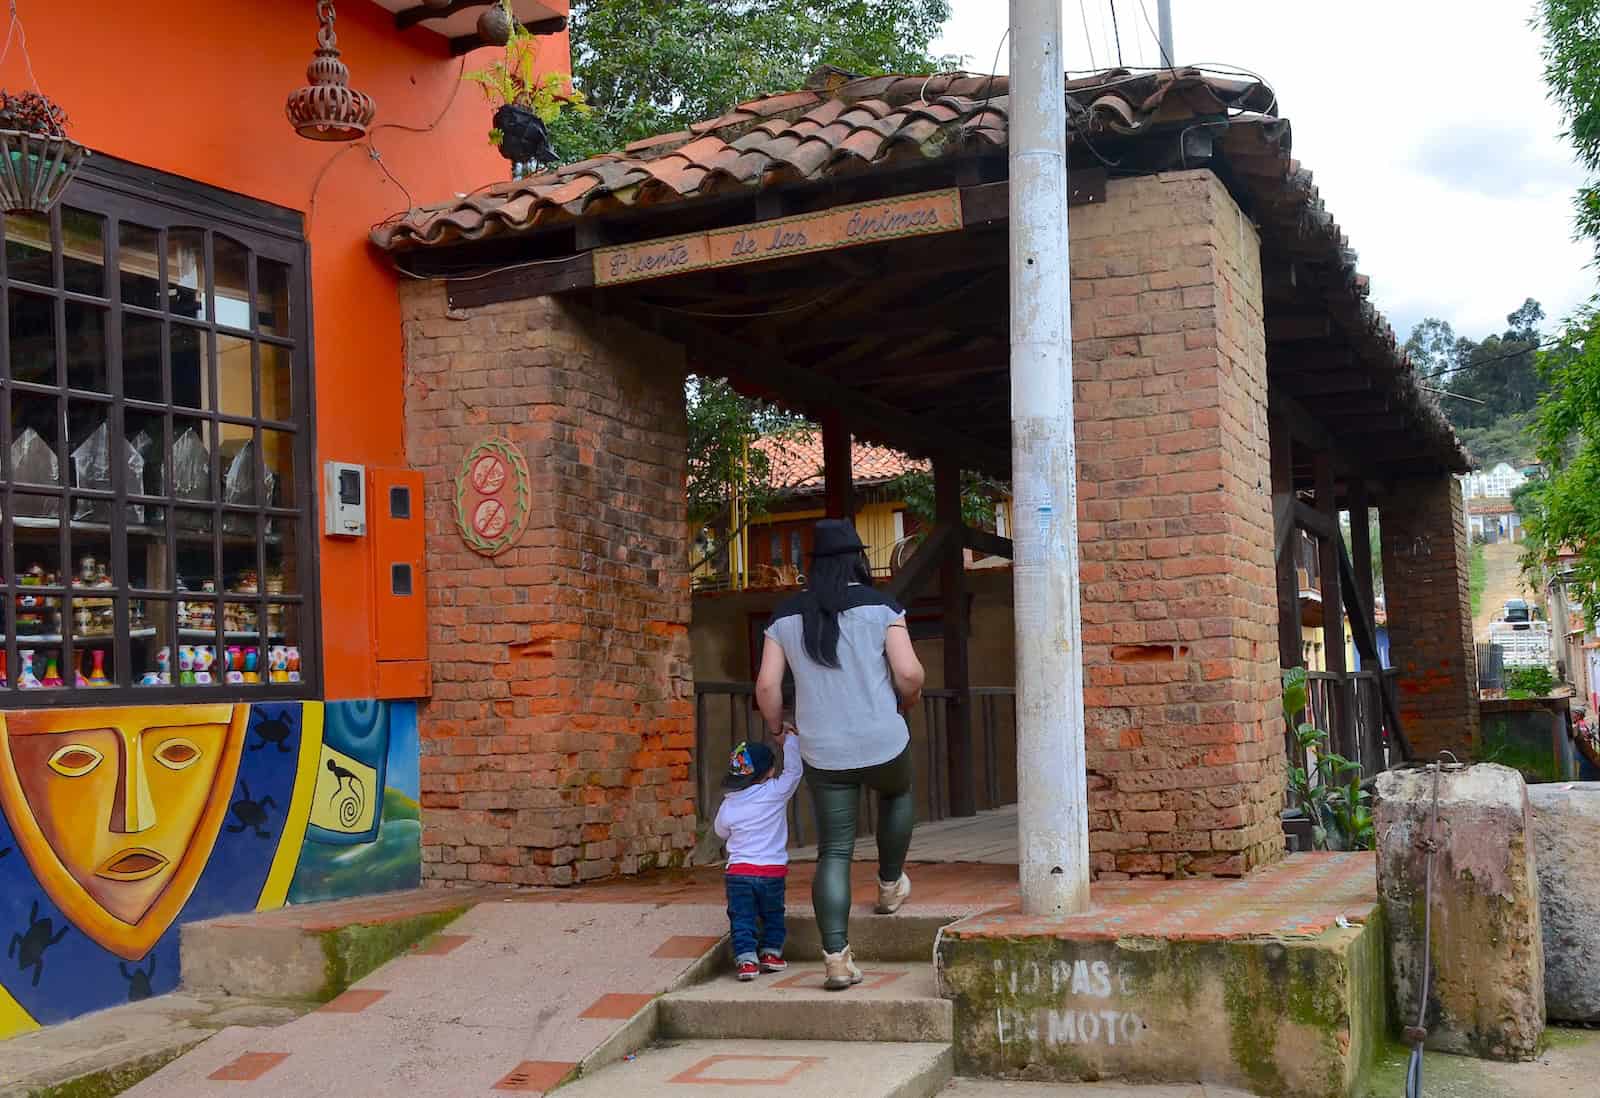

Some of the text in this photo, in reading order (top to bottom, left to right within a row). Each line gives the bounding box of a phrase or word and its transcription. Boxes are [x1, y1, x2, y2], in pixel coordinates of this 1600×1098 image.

[609, 243, 690, 276] Puente
[731, 233, 758, 256] de
[766, 226, 808, 249] las
[1048, 1009, 1140, 1047] MOTO
